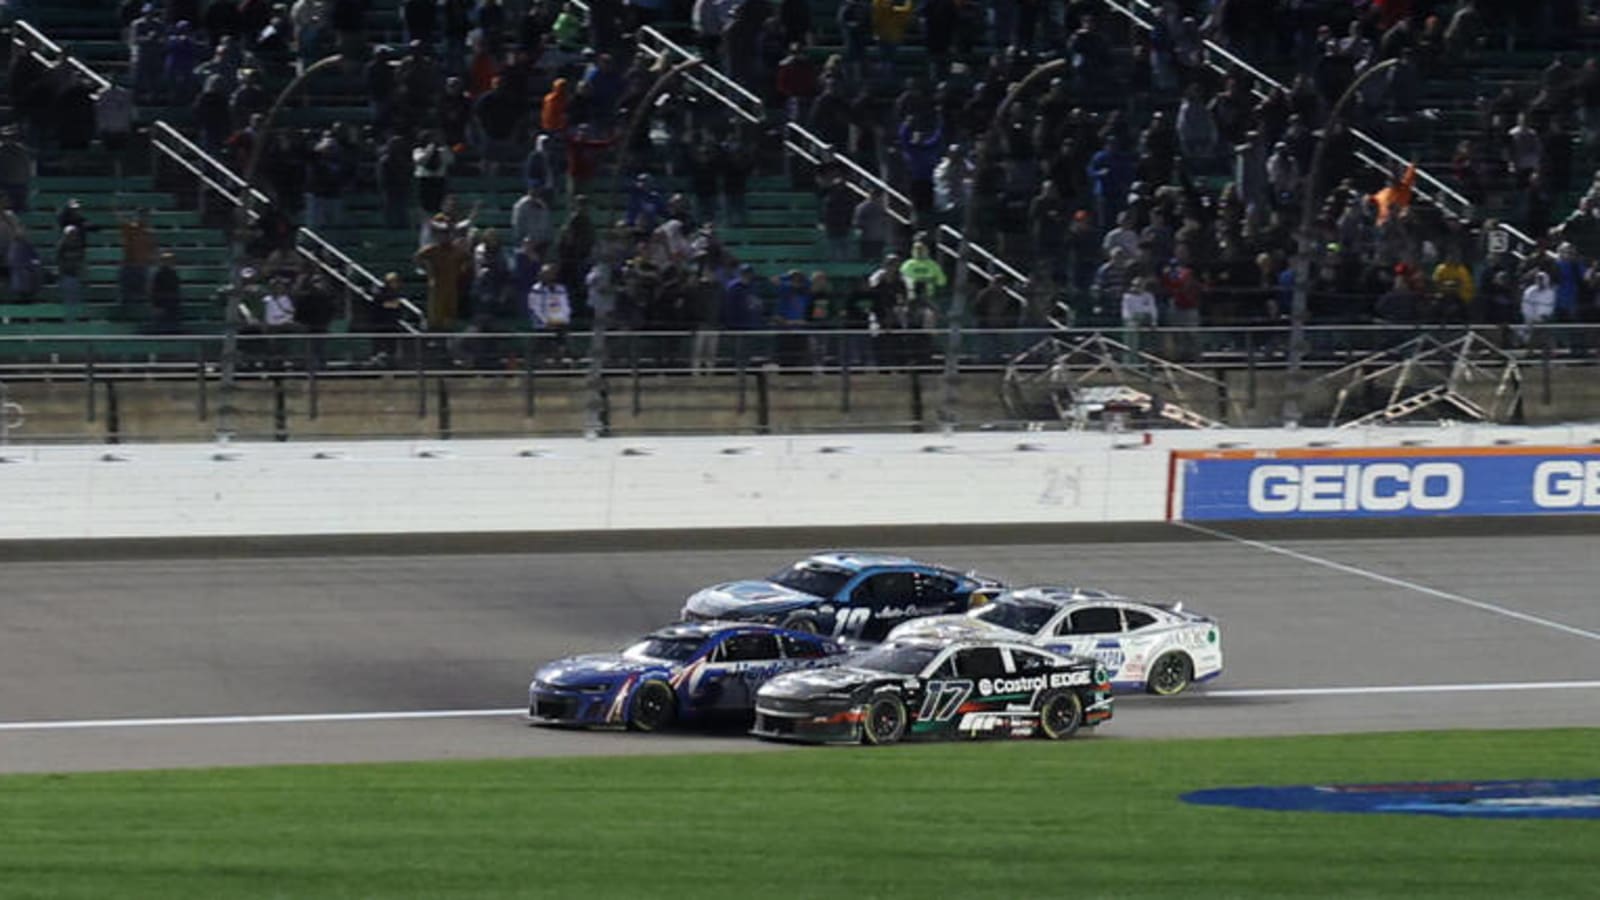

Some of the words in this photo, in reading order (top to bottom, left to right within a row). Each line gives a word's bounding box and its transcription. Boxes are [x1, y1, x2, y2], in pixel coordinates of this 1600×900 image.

[1248, 462, 1464, 513] GEICO
[917, 680, 974, 722] 17
[994, 674, 1048, 693] Castrol
[1050, 670, 1091, 688] EDGE
